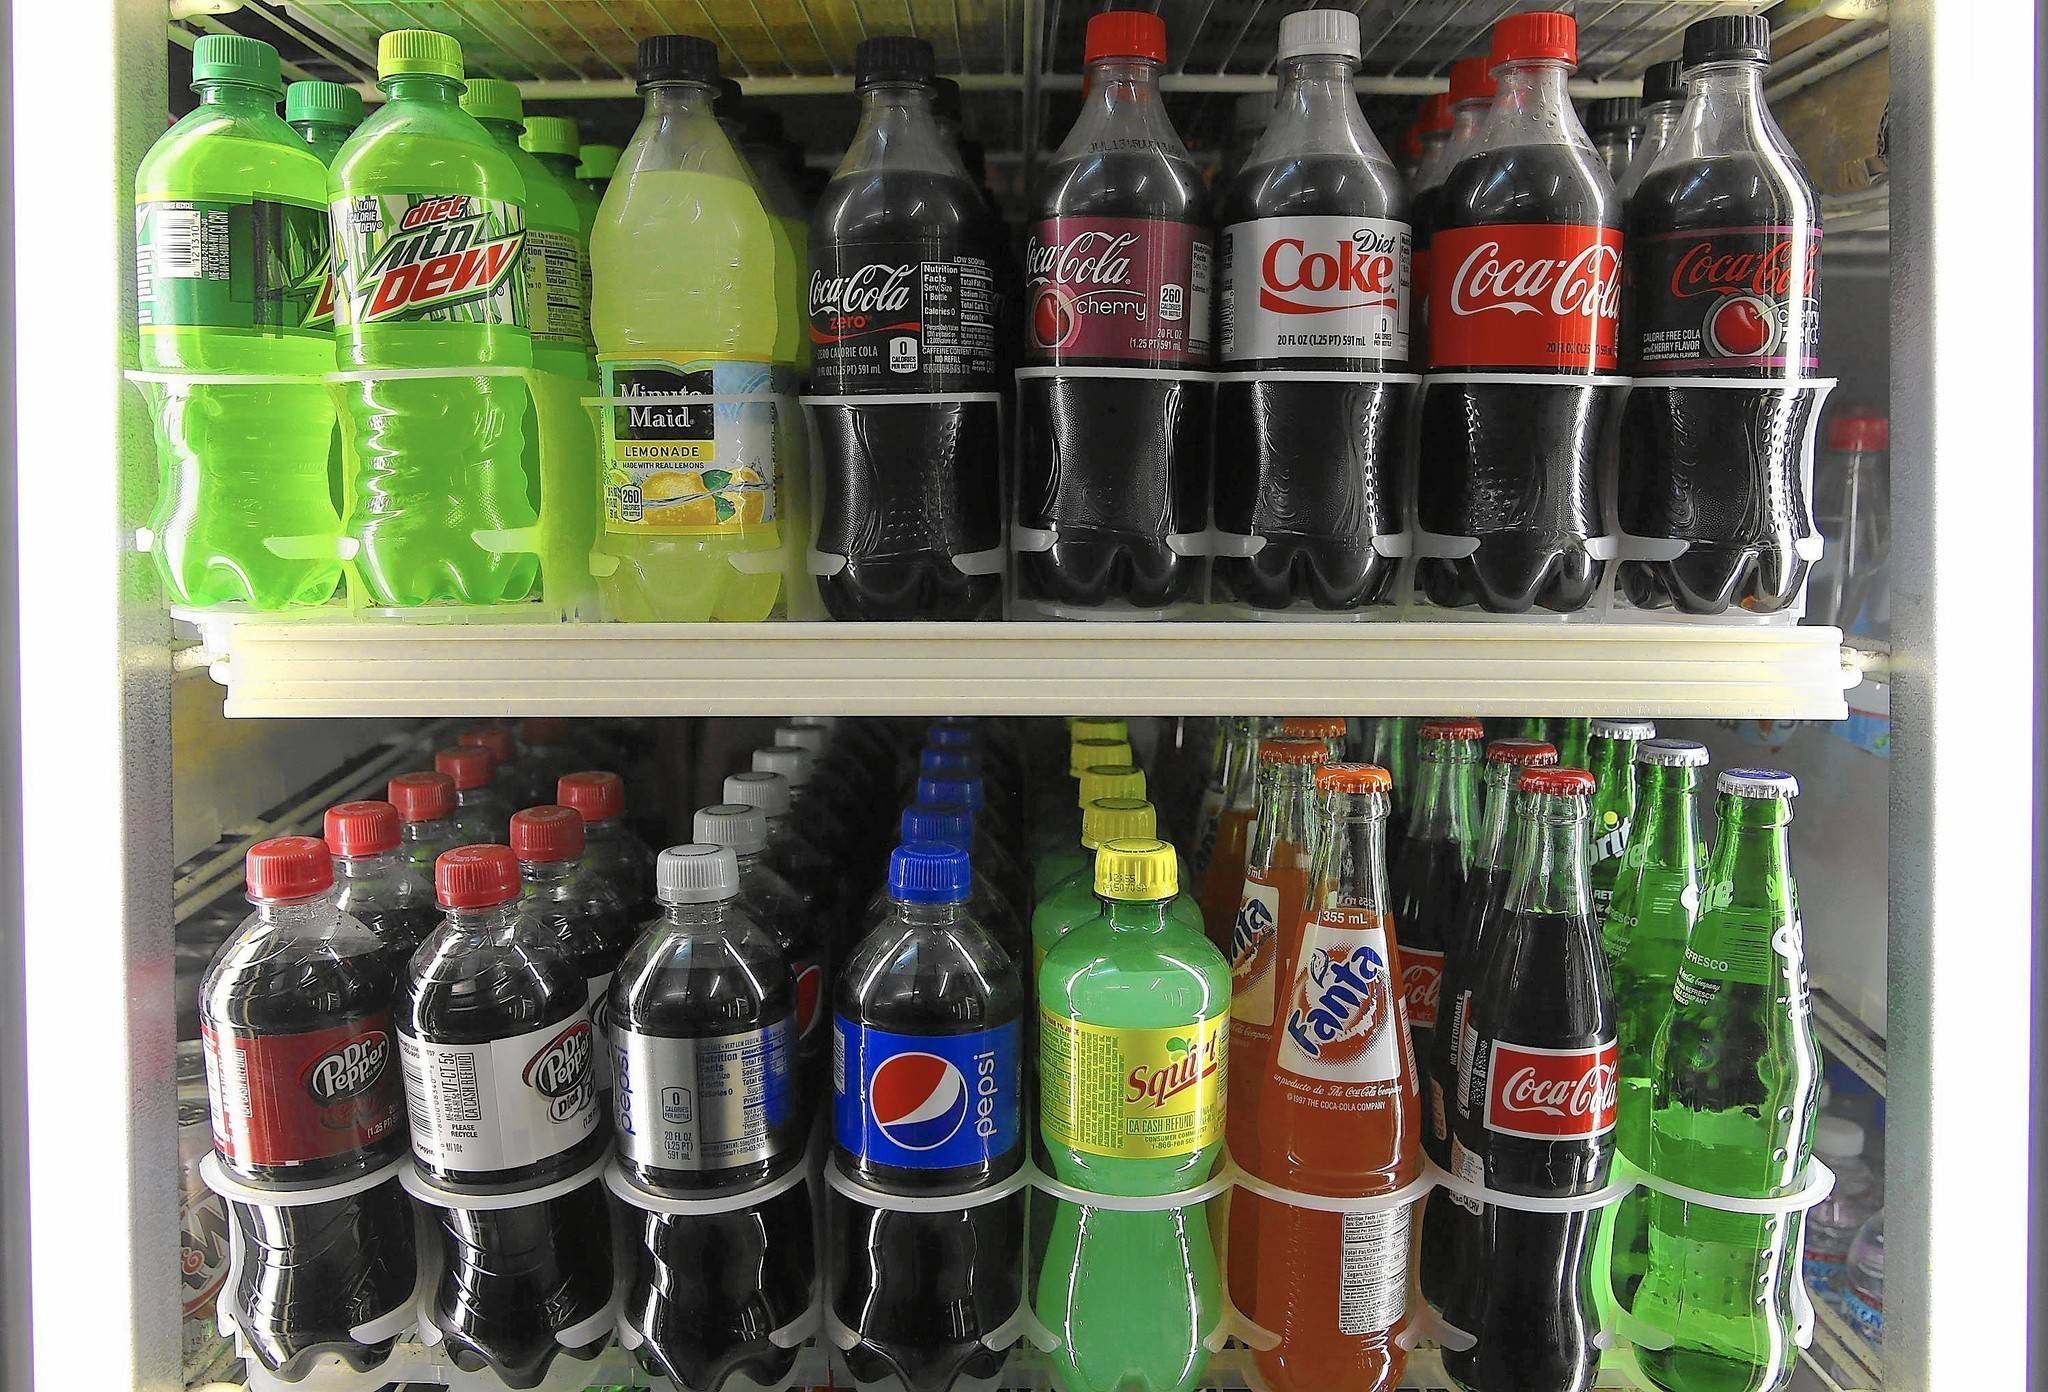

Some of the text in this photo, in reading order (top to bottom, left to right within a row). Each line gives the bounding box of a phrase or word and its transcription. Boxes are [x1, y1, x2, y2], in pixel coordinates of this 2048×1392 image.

[359, 200, 376, 210] LOW
[403, 195, 468, 230] diet
[192, 225, 200, 263] 121310
[1352, 228, 1396, 254] Diet
[371, 222, 475, 278] Mtn
[953, 256, 967, 264] LOW
[1026, 231, 1141, 287] Coca-Cola
[1262, 238, 1394, 294] Coke
[924, 264, 958, 274] Nutrition
[924, 274, 947, 283] Facts
[1450, 241, 1622, 319] Coca-Cola
[809, 264, 919, 317] Coca-Cola
[940, 284, 953, 293] Size
[1162, 287, 1181, 304] 260
[924, 293, 928, 301] 1
[924, 307, 956, 316] Calories 0
[1076, 296, 1147, 321] cherry
[830, 315, 866, 330] zero
[1157, 328, 1183, 340] 20 FL OZ
[1277, 334, 1367, 347] 20 FL OZ (1.25 PT) 591 mL
[1643, 329, 1700, 343] CALORIE FREE COLA
[899, 341, 908, 356] 0
[1129, 337, 1148, 349] (1.25
[1160, 338, 1172, 350] 591
[1172, 339, 1182, 351] mL
[1546, 342, 1556, 353] 20
[1651, 340, 1700, 353] CHERRY FLAVOR
[830, 346, 857, 359] CALORIE
[858, 345, 879, 357] COLA
[935, 355, 961, 364] NO REFILL
[858, 364, 870, 375] 591
[870, 364, 882, 375] mL
[629, 407, 692, 428] Maid
[625, 446, 700, 457] LEMONADE
[623, 489, 639, 503] 260
[1323, 910, 1368, 924] 355 mL
[1286, 945, 1384, 1057] Fanta
[1450, 993, 1464, 1066] NO RETORNABLE
[563, 1030, 582, 1063] Dr
[343, 1039, 371, 1071] Dr
[313, 1040, 386, 1098] Pepper
[538, 1033, 590, 1093] Pepper
[742, 1059, 757, 1067] Total
[439, 1052, 459, 1093] VT-CT 5¢
[742, 1066, 763, 1077] Sodium
[457, 1056, 479, 1118] CA CASH REFUND
[742, 1077, 757, 1086] Total
[1279, 1077, 1312, 1093] producto
[1313, 1084, 1325, 1095] de
[1328, 1085, 1342, 1097] The
[615, 1047, 637, 1136] pepsi
[973, 1051, 998, 1137] pepsi
[1502, 1064, 1618, 1117] Coca-Cola
[557, 1089, 579, 1118] Diet
[672, 1092, 680, 1106] 0
[1307, 1098, 1319, 1108] THE
[1320, 1100, 1356, 1111] COCA-COLA
[1357, 1100, 1386, 1111] COMPANY
[452, 1123, 476, 1131] PLEASE
[1129, 1119, 1140, 1133] CA
[1142, 1117, 1163, 1133] CASH
[1165, 1114, 1194, 1131] REFUND
[664, 1130, 692, 1142] 20 FL OZ
[1144, 1134, 1177, 1143] CONSUMER
[664, 1140, 694, 1152] (1.25 PT)
[667, 1150, 679, 1160] 591
